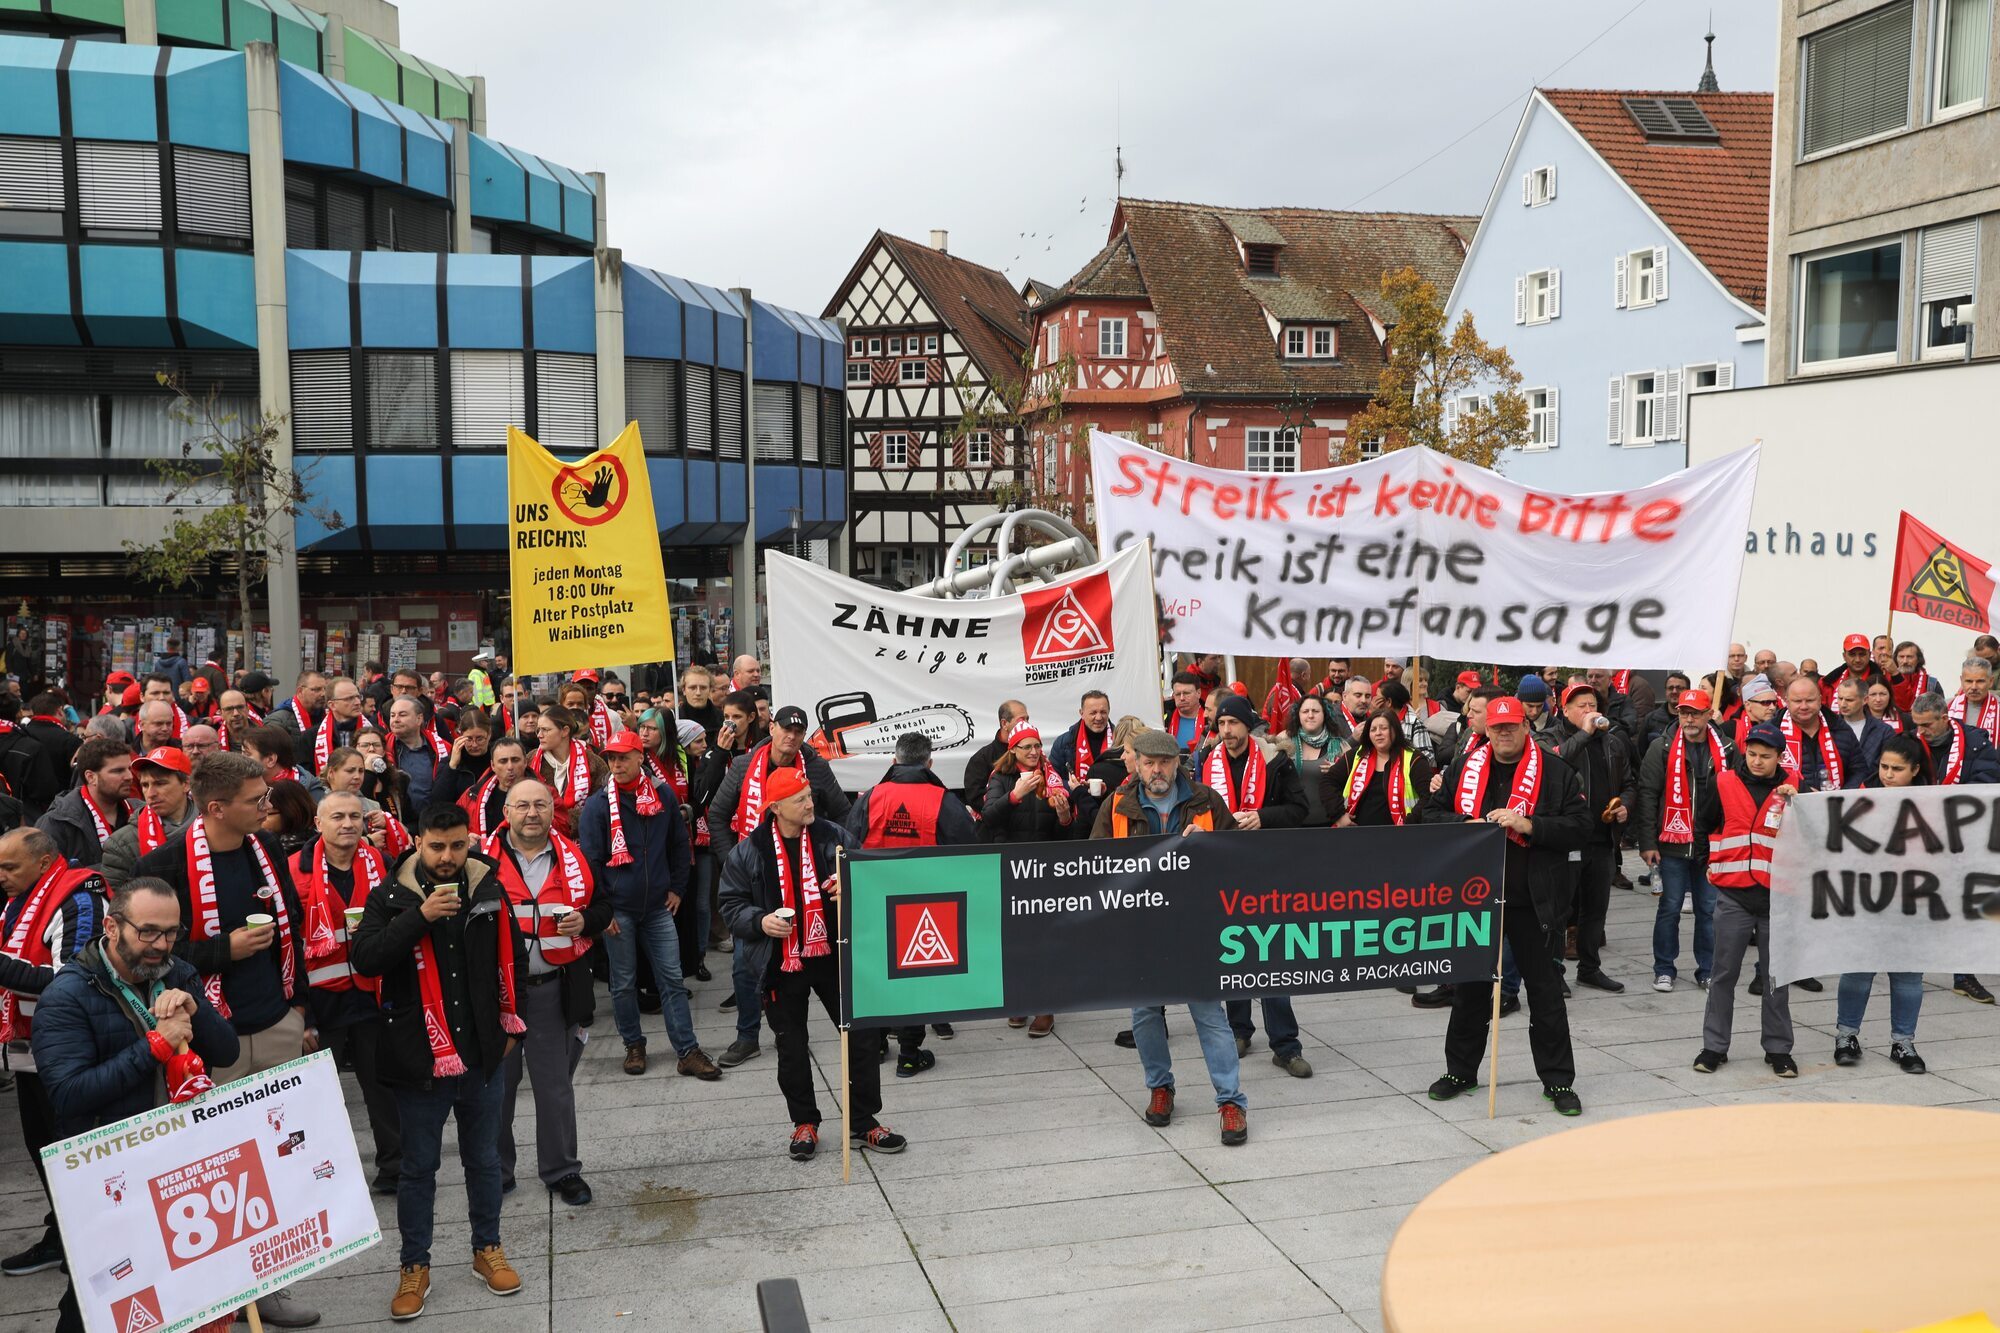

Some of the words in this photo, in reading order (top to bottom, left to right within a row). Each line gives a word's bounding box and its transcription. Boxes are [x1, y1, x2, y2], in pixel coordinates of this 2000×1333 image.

[516, 503, 549, 523] UNS
[1110, 454, 1293, 523] Streik
[1307, 476, 1361, 520] ist
[1375, 464, 1501, 530] keine
[1519, 492, 1684, 545] Bitte
[1279, 530, 1344, 585] ist
[1357, 527, 1485, 586] eine
[1746, 522, 1877, 557] athaus
[533, 566, 570, 585] jeden
[574, 563, 623, 579] Montag
[548, 583, 586, 601] 18:00
[590, 582, 616, 597] Uhr
[533, 606, 567, 624] Alter
[571, 600, 634, 621] Postplatz
[832, 602, 992, 639] ZÄHNE
[1244, 584, 1666, 655] Kampfansage
[549, 621, 625, 642] Waiblingen
[875, 644, 988, 674] zeigen
[1025, 653, 1115, 672] VERTRAUENSLEUTE
[1026, 669, 1059, 683] POWER
[1061, 667, 1076, 678] BEI
[1079, 661, 1115, 675] STIHL
[864, 725, 946, 746] Vertraleute
[879, 726, 890, 734] IG
[894, 718, 926, 731] Metall
[1010, 857, 1046, 880] Wir
[1053, 853, 1152, 879] schützen
[1157, 851, 1191, 872] die
[1010, 890, 1093, 917] inneren
[1098, 887, 1170, 912] Werte.
[1219, 882, 1453, 917] Vertrauensleute
[1461, 876, 1491, 904] @
[1219, 911, 1491, 964] SYNTEGON
[1219, 968, 1334, 991] PROCESSING
[1339, 968, 1350, 982] &
[1356, 959, 1452, 981] PACKAGING
[77, 1120, 129, 1146] SYNTEGON
[210, 1075, 254, 1097] SYNTEGON
[268, 1056, 310, 1076] SYNTEGON
[64, 1114, 187, 1170] SYNTEGON
[191, 1075, 303, 1124] Remshalden
[156, 1170, 184, 1190] WER
[184, 1162, 204, 1182] DIE
[204, 1147, 242, 1171] PREISE
[160, 1177, 201, 1201] KENNT,
[200, 1165, 229, 1184] WILL
[166, 1171, 270, 1260] 8%
[249, 1217, 317, 1258] SOLIDARITÄT
[210, 1287, 258, 1313] SYNTEGON
[273, 1261, 315, 1286] SYNTEGON
[329, 1235, 370, 1260] SYNTEGON
[255, 1255, 305, 1280] TARIFBEWEGUNG
[305, 1245, 320, 1259] 2022
